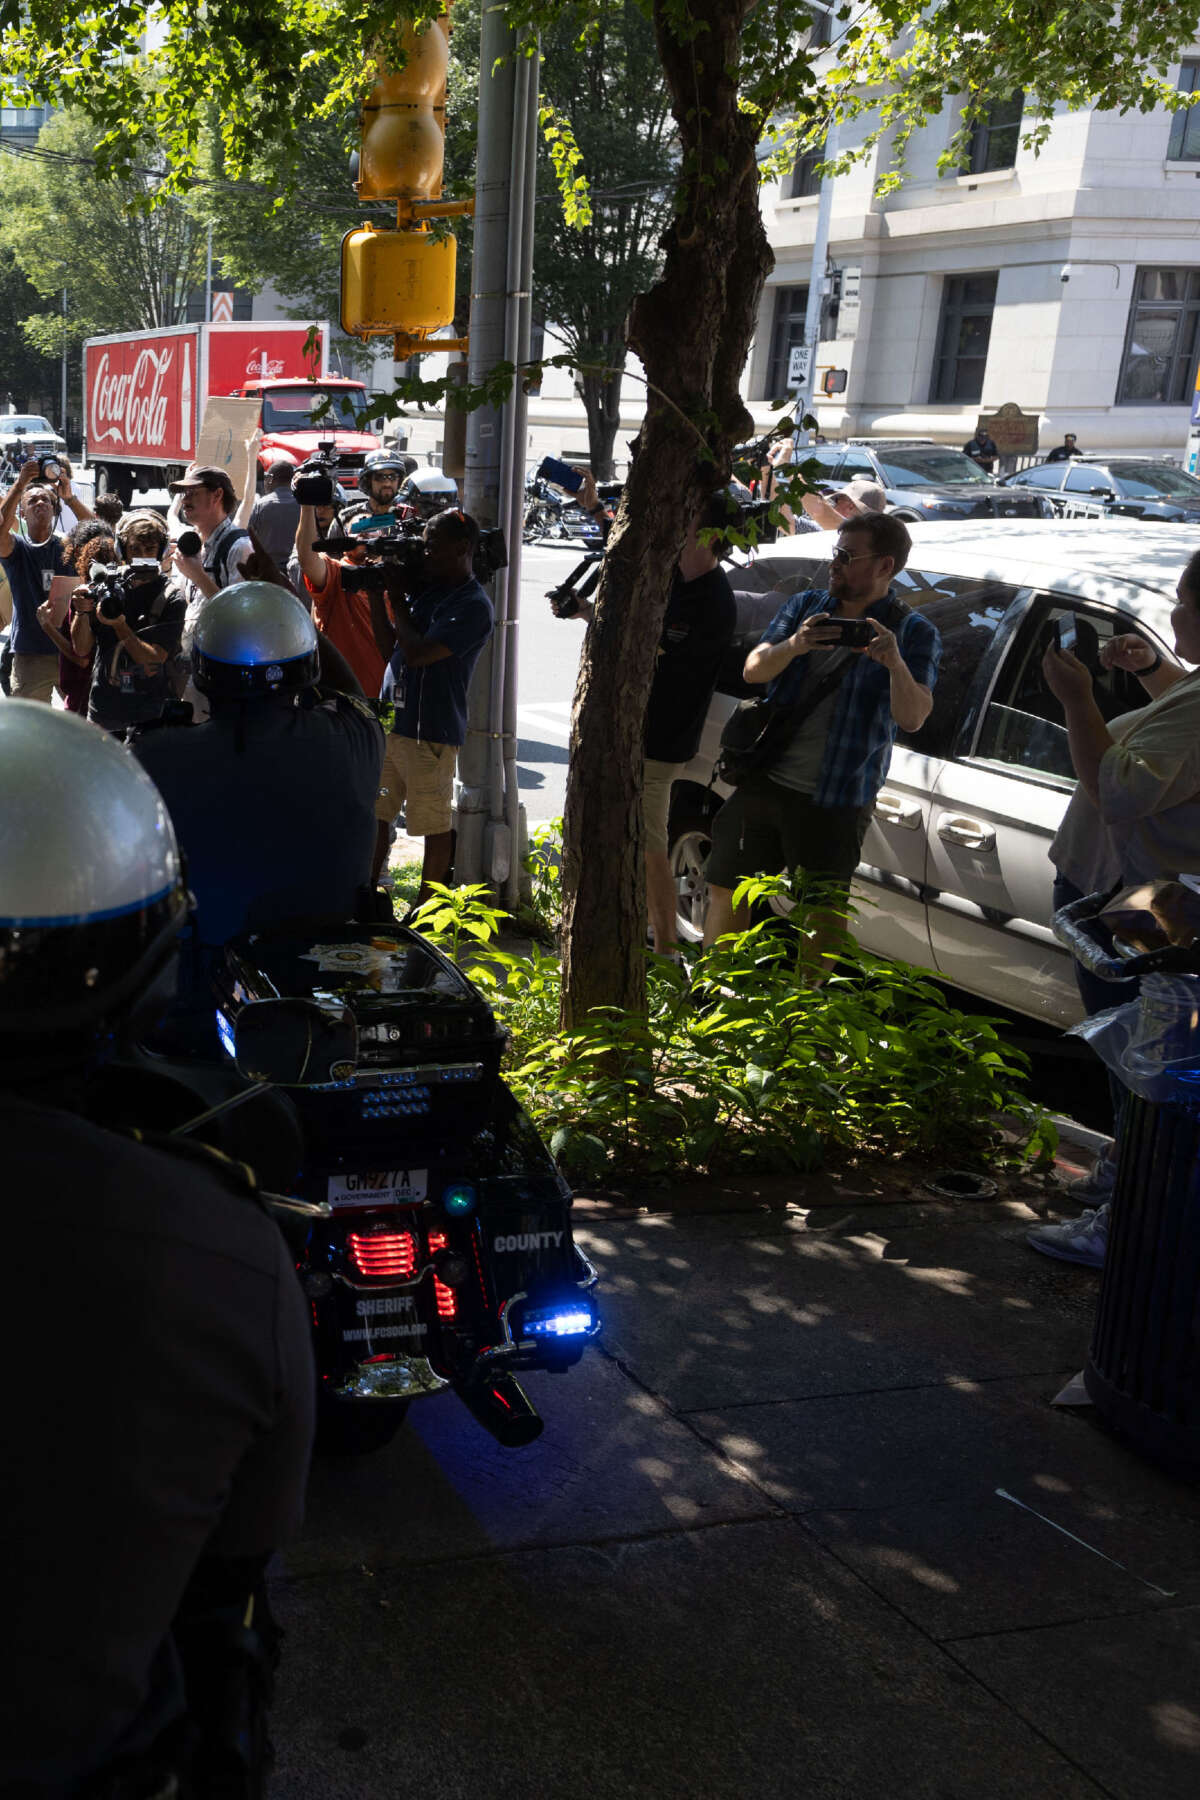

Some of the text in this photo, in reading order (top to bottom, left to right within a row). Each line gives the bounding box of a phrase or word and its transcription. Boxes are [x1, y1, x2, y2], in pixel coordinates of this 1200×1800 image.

[793, 350, 809, 360] ONE
[792, 362, 808, 371] WAY
[92, 347, 174, 446] Coca-Cola
[494, 1231, 564, 1253] COUNTY
[356, 1297, 414, 1317] SHERIFF
